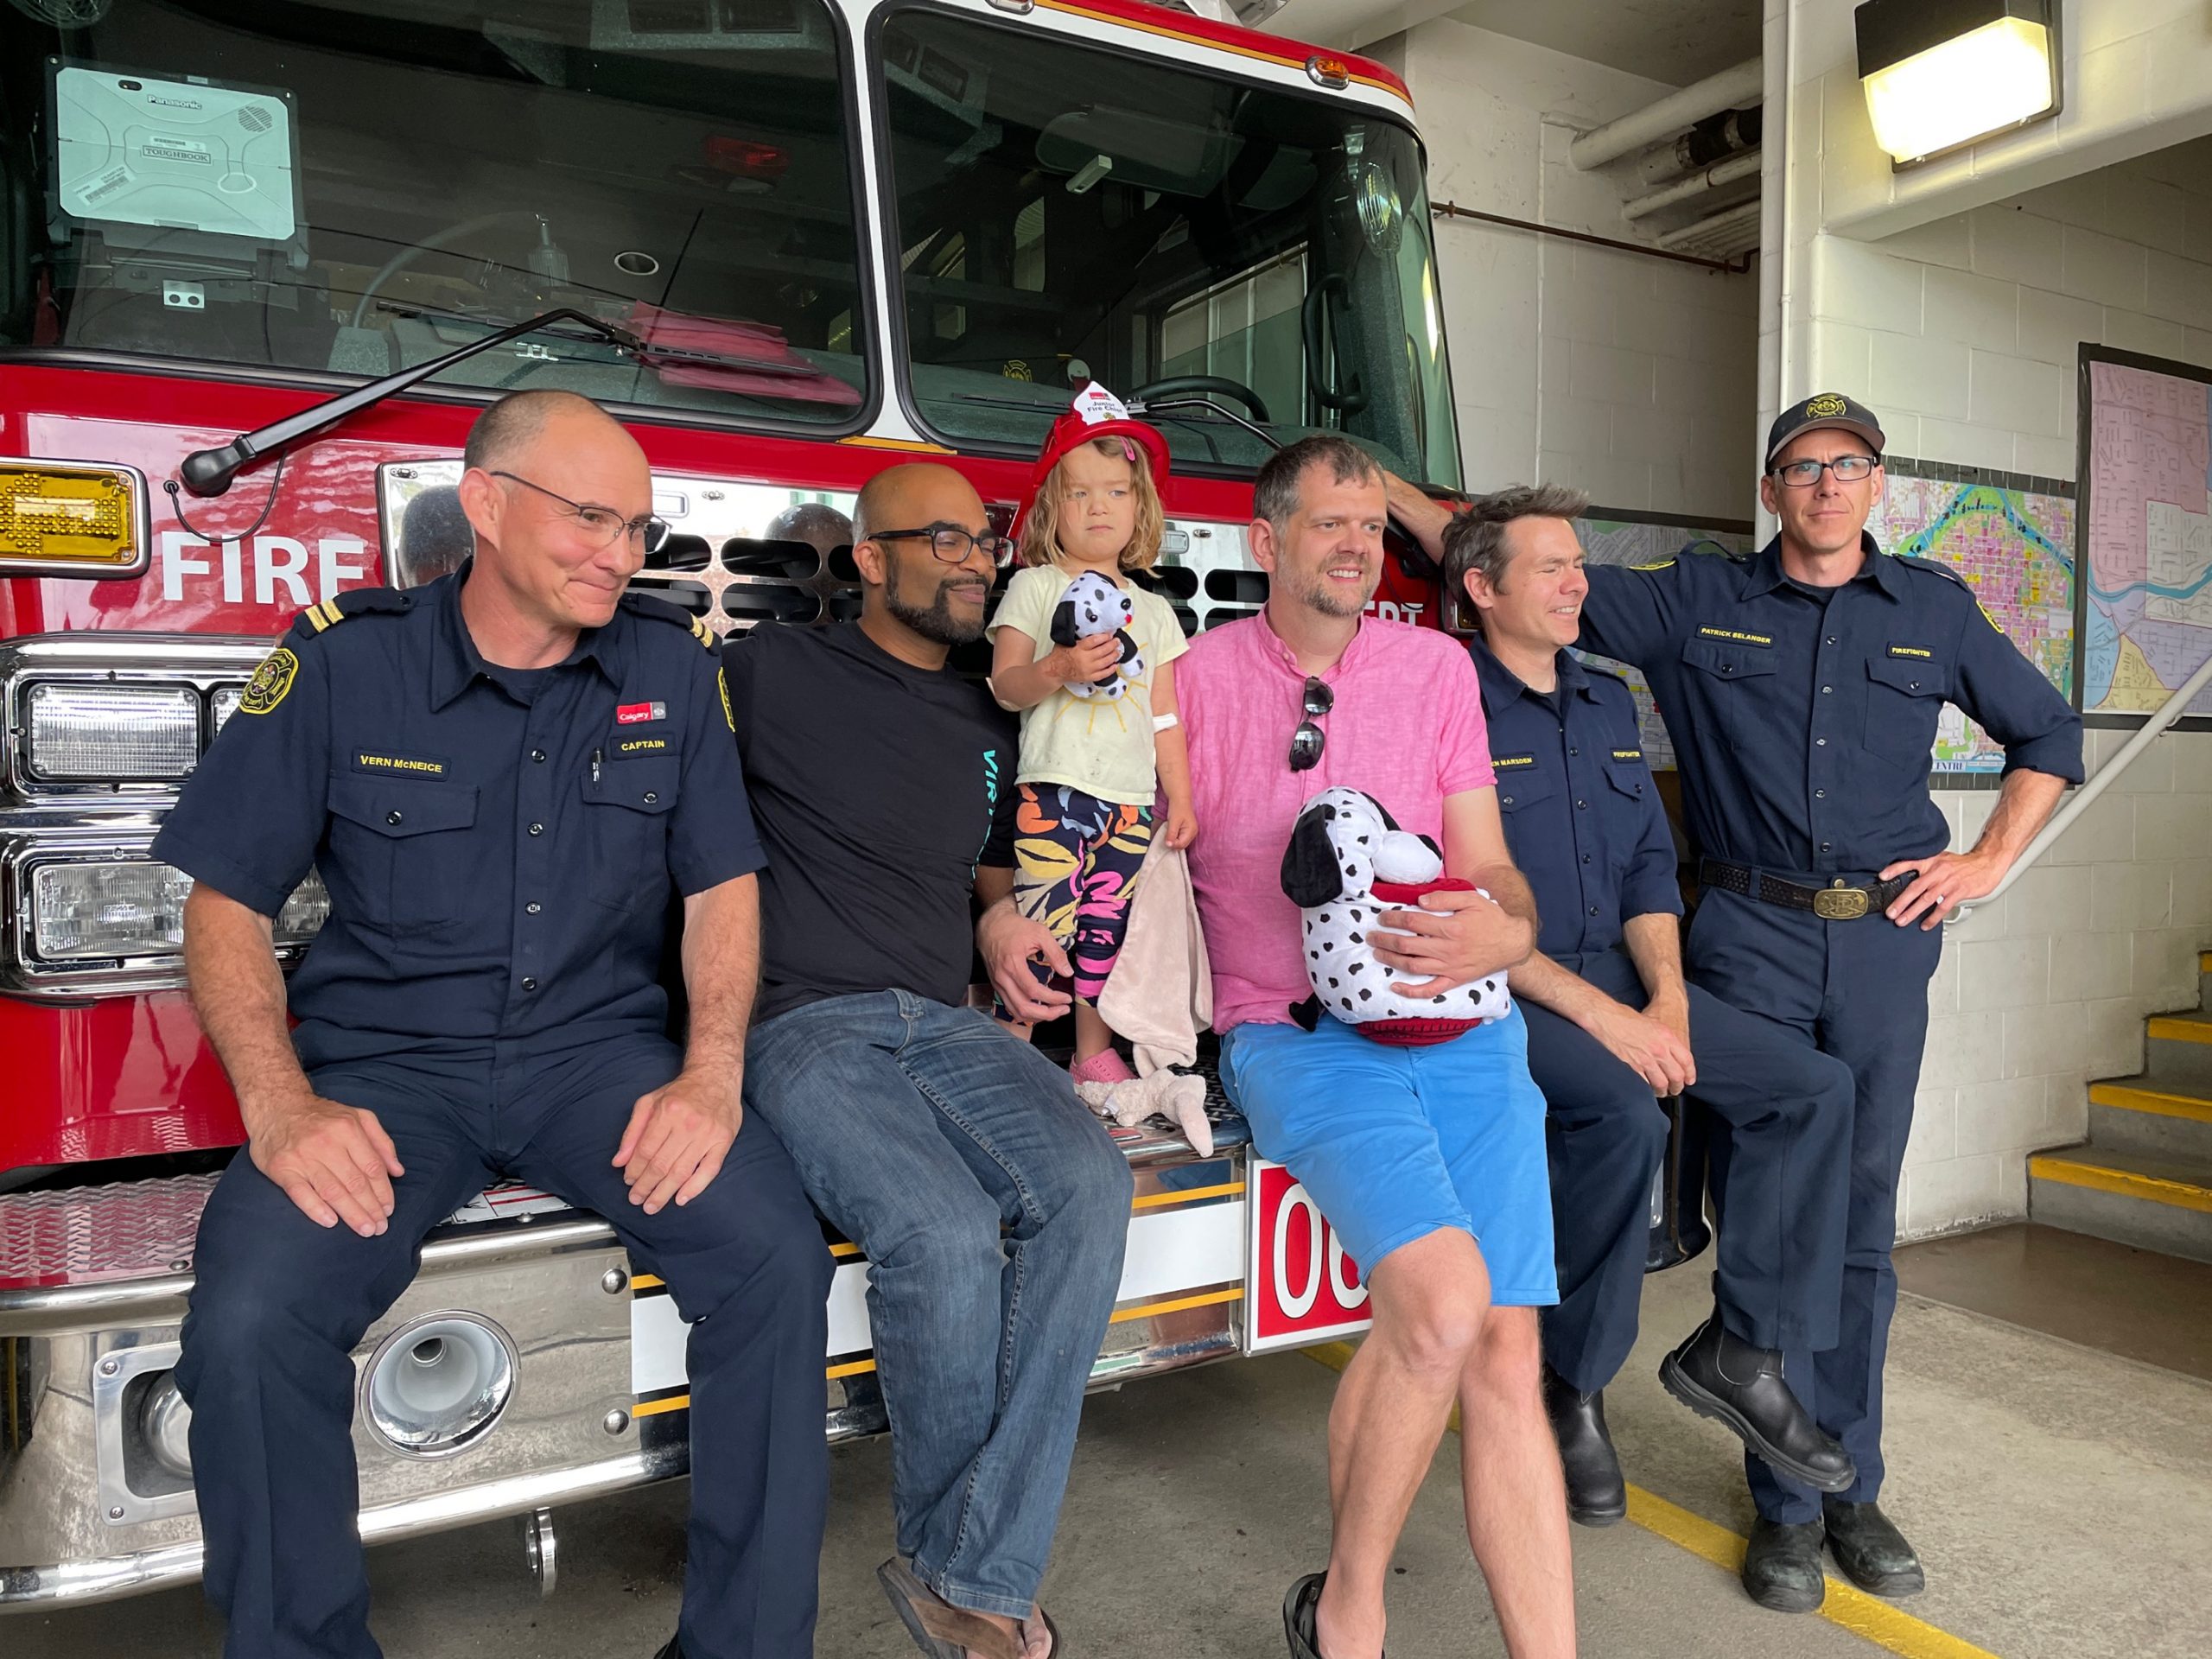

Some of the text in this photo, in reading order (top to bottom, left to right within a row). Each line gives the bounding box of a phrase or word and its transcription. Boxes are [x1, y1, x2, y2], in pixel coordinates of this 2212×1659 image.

[147, 94, 202, 110] Panasonic
[145, 148, 208, 162] TOUGHBOOK
[162, 531, 365, 605] FIRE
[1700, 627, 1771, 644] PATRICK BELANGER
[1891, 647, 1931, 657] FIREFIGHTER
[620, 711, 649, 721] Calgary
[620, 740, 665, 751] CAPTAIN
[359, 754, 442, 773] VERN McNEICE
[1500, 757, 1533, 766] MARSDEN
